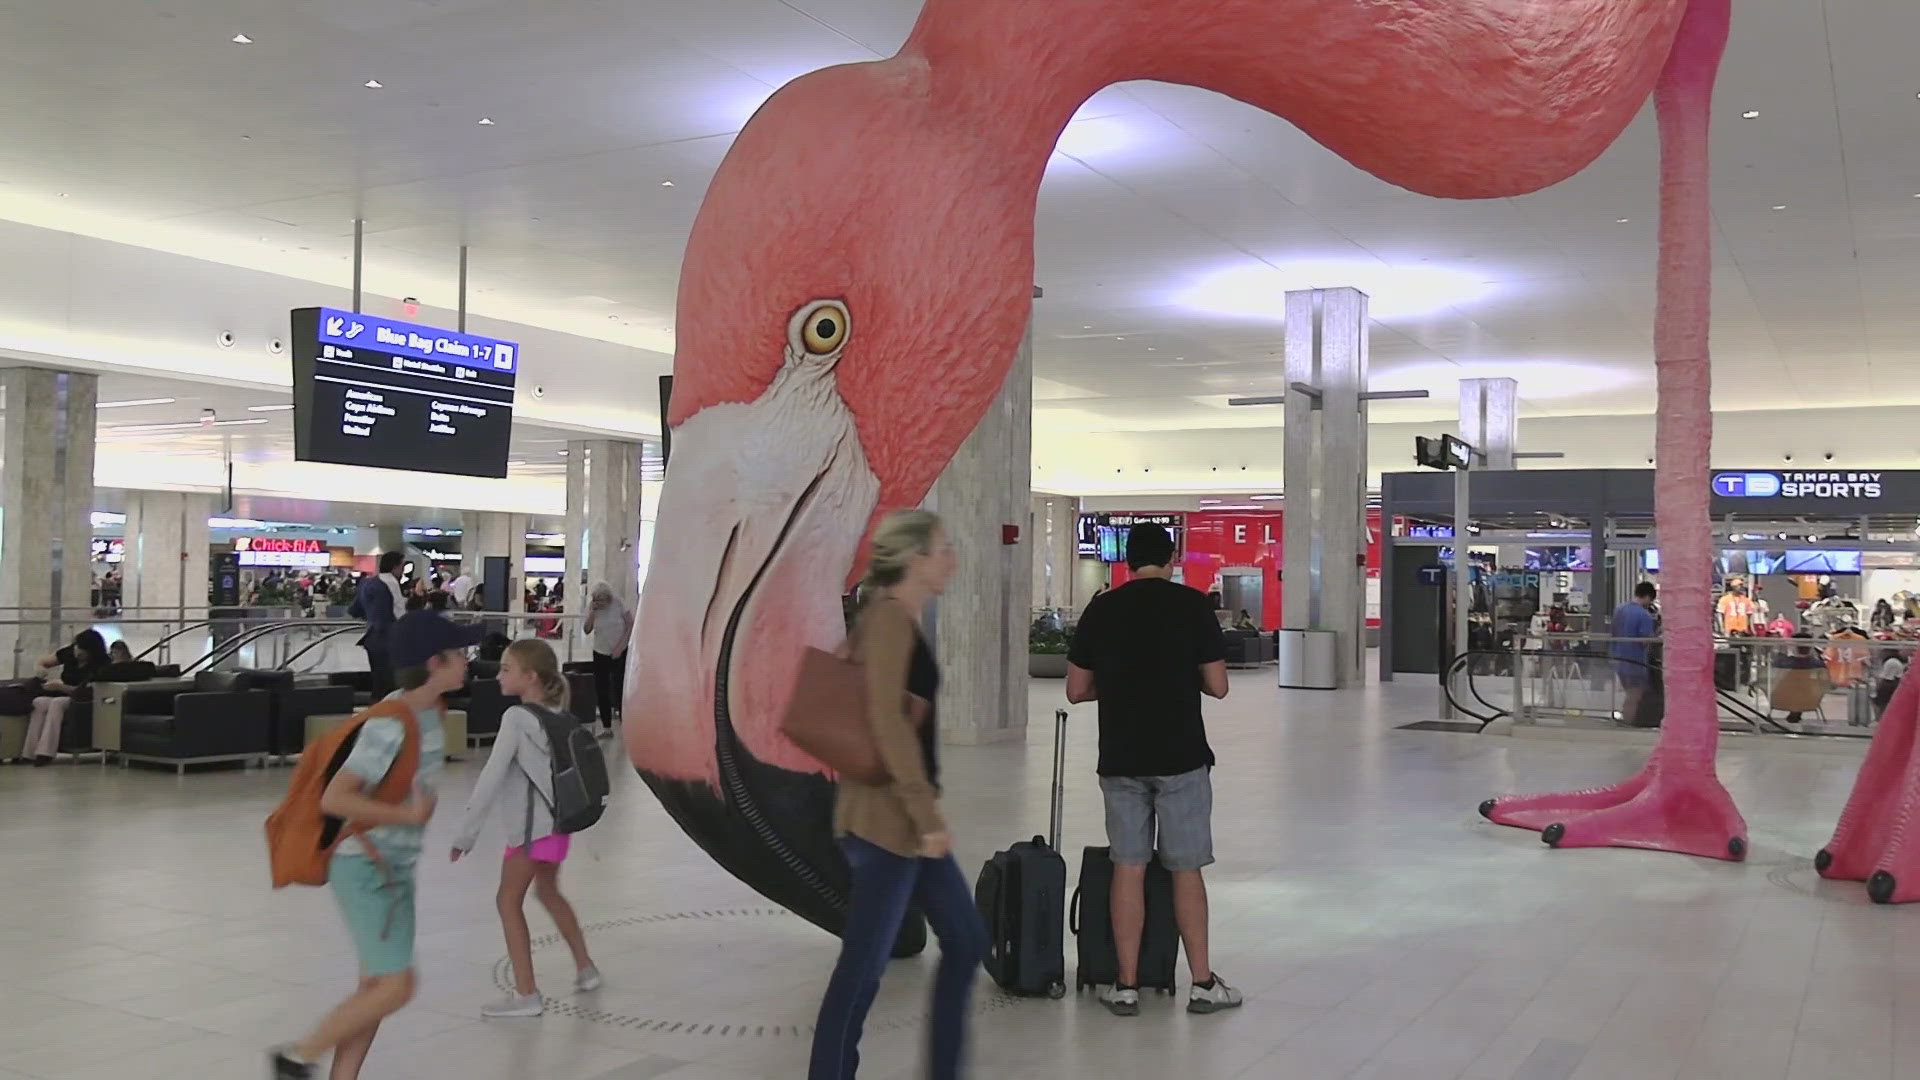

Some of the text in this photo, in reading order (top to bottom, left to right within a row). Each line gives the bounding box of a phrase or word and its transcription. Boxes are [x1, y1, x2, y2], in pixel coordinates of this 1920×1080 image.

[376, 326, 492, 360] Blue Bag Claim 1-7
[1782, 472, 1881, 482] TAMPA BAY
[1782, 483, 1881, 497] SPORTS
[251, 538, 320, 552] Chick-fil-A
